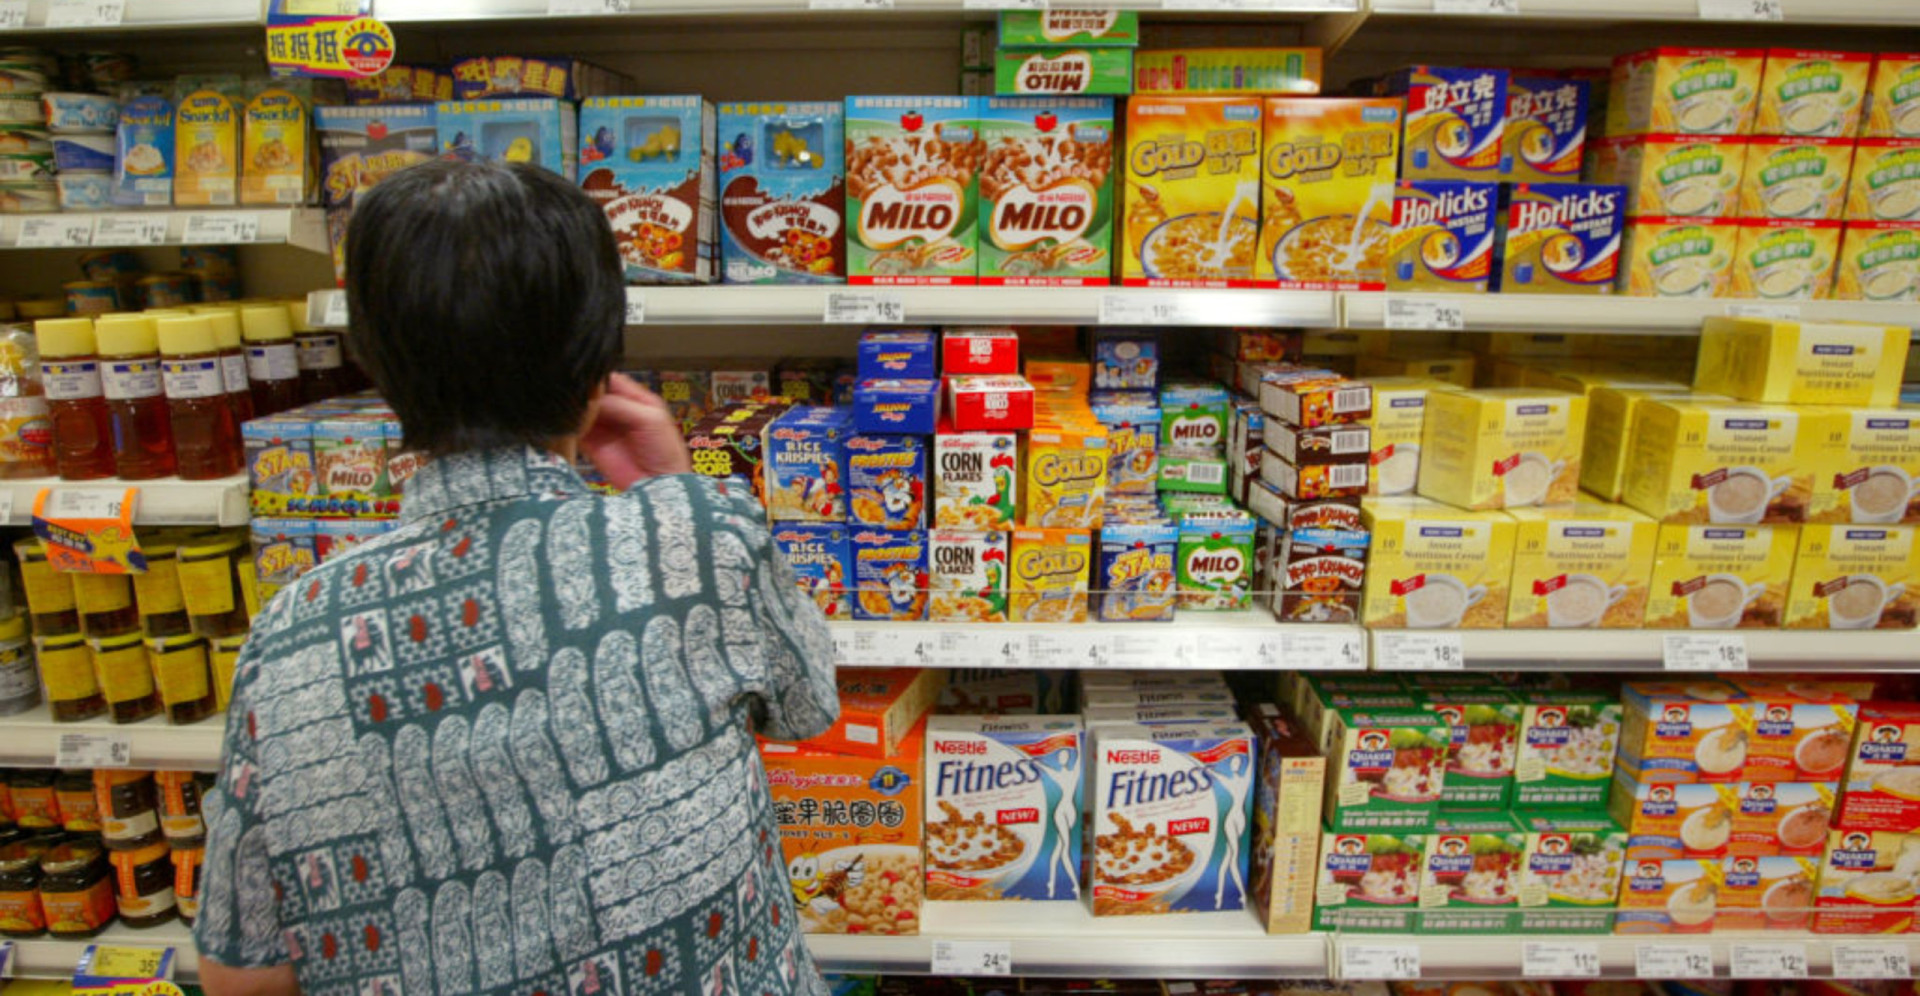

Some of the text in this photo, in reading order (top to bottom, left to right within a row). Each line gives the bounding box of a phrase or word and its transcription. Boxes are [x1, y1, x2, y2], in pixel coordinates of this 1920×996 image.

[268, 30, 340, 65] 抵抵抵
[1025, 74, 1083, 91] MILO
[1425, 74, 1496, 111] 好立克
[1510, 85, 1577, 118] 好立克
[1131, 141, 1205, 178] GOLD
[1268, 144, 1342, 179] GOLD
[867, 201, 953, 231] MILO
[1400, 187, 1488, 228] Horlicks
[1518, 190, 1615, 231] Horlicks
[999, 202, 1086, 231] MILO
[1447, 212, 1487, 229] INSTANT
[1570, 215, 1614, 232] INSTANT
[876, 302, 891, 316] 15
[1174, 424, 1217, 439] MILO
[786, 441, 822, 452] RICE
[692, 450, 731, 463] COCO
[776, 452, 832, 466] KRISPIES
[941, 452, 983, 472] CORN
[943, 472, 983, 483] FLAKES
[1033, 453, 1102, 486] GOLD
[330, 471, 373, 486] MILO
[789, 543, 825, 553] RICE
[935, 546, 975, 565] CORN
[936, 565, 975, 575] FLAKES
[1016, 549, 1085, 581] GOLD
[1190, 556, 1240, 573] MILO
[1434, 646, 1451, 661] 18
[1351, 750, 1394, 762] QUAKER
[936, 757, 1042, 798] Fitness
[1106, 764, 1215, 809] Fitness
[984, 953, 999, 968] 24
